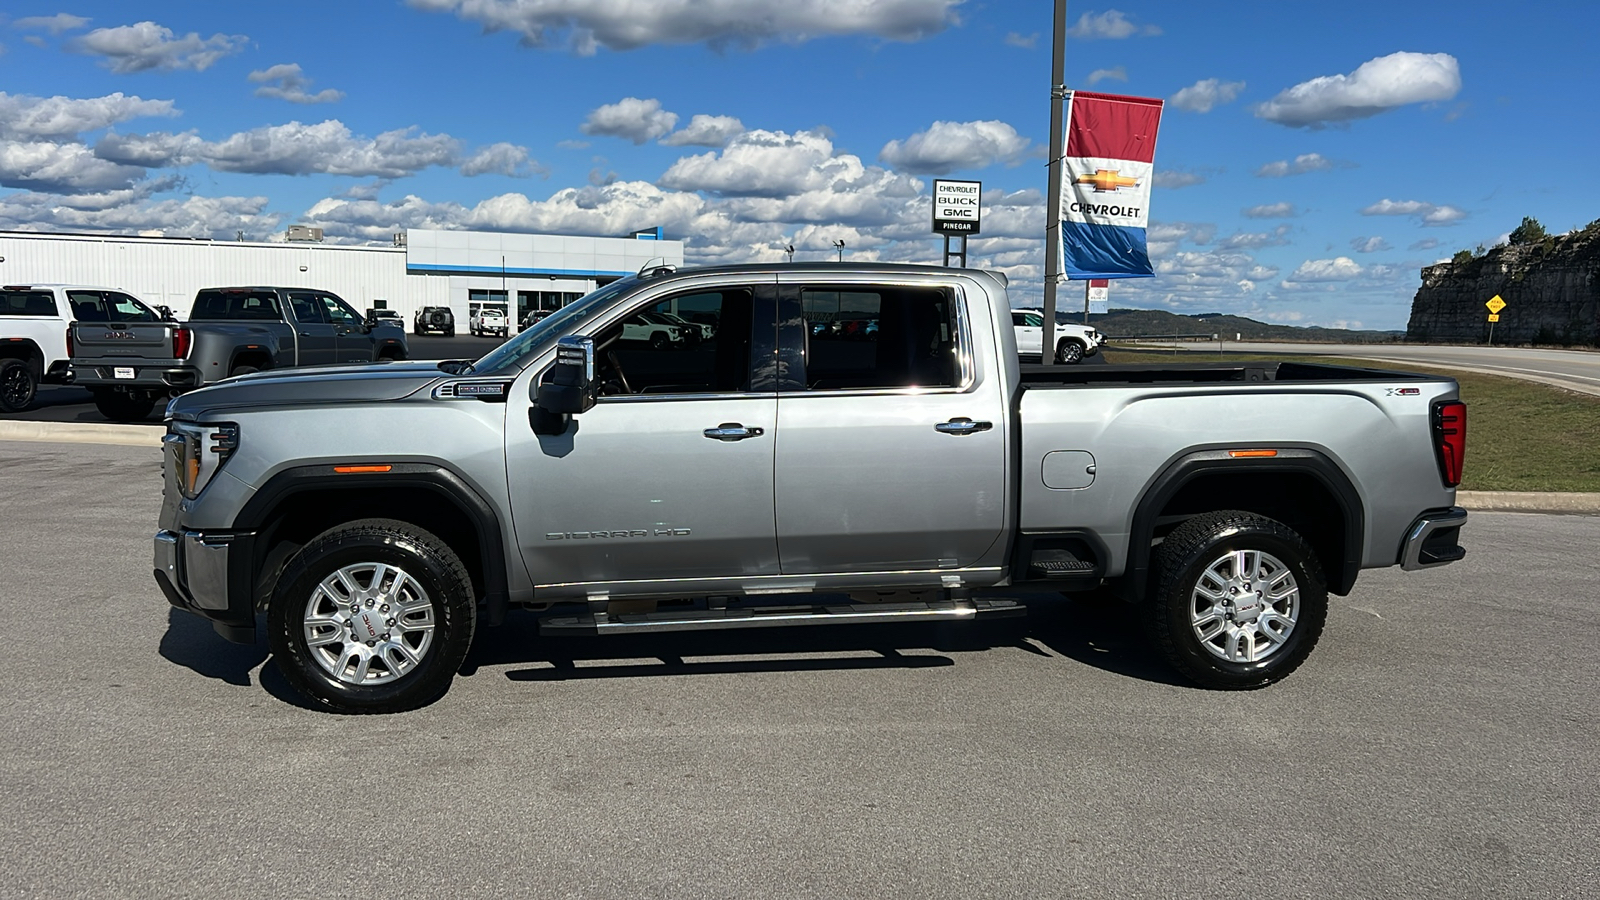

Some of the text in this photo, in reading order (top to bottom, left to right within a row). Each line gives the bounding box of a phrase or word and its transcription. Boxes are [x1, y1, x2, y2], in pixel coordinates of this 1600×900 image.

[939, 185, 977, 194] CHEVROLET
[938, 197, 977, 206] BUICK
[943, 208, 972, 217] GMC
[1070, 202, 1140, 218] CHEVROLET
[943, 222, 971, 230] PINEGAR
[104, 331, 136, 339] GMC
[545, 528, 692, 540] SIERRA HD
[362, 613, 376, 637] GMC
